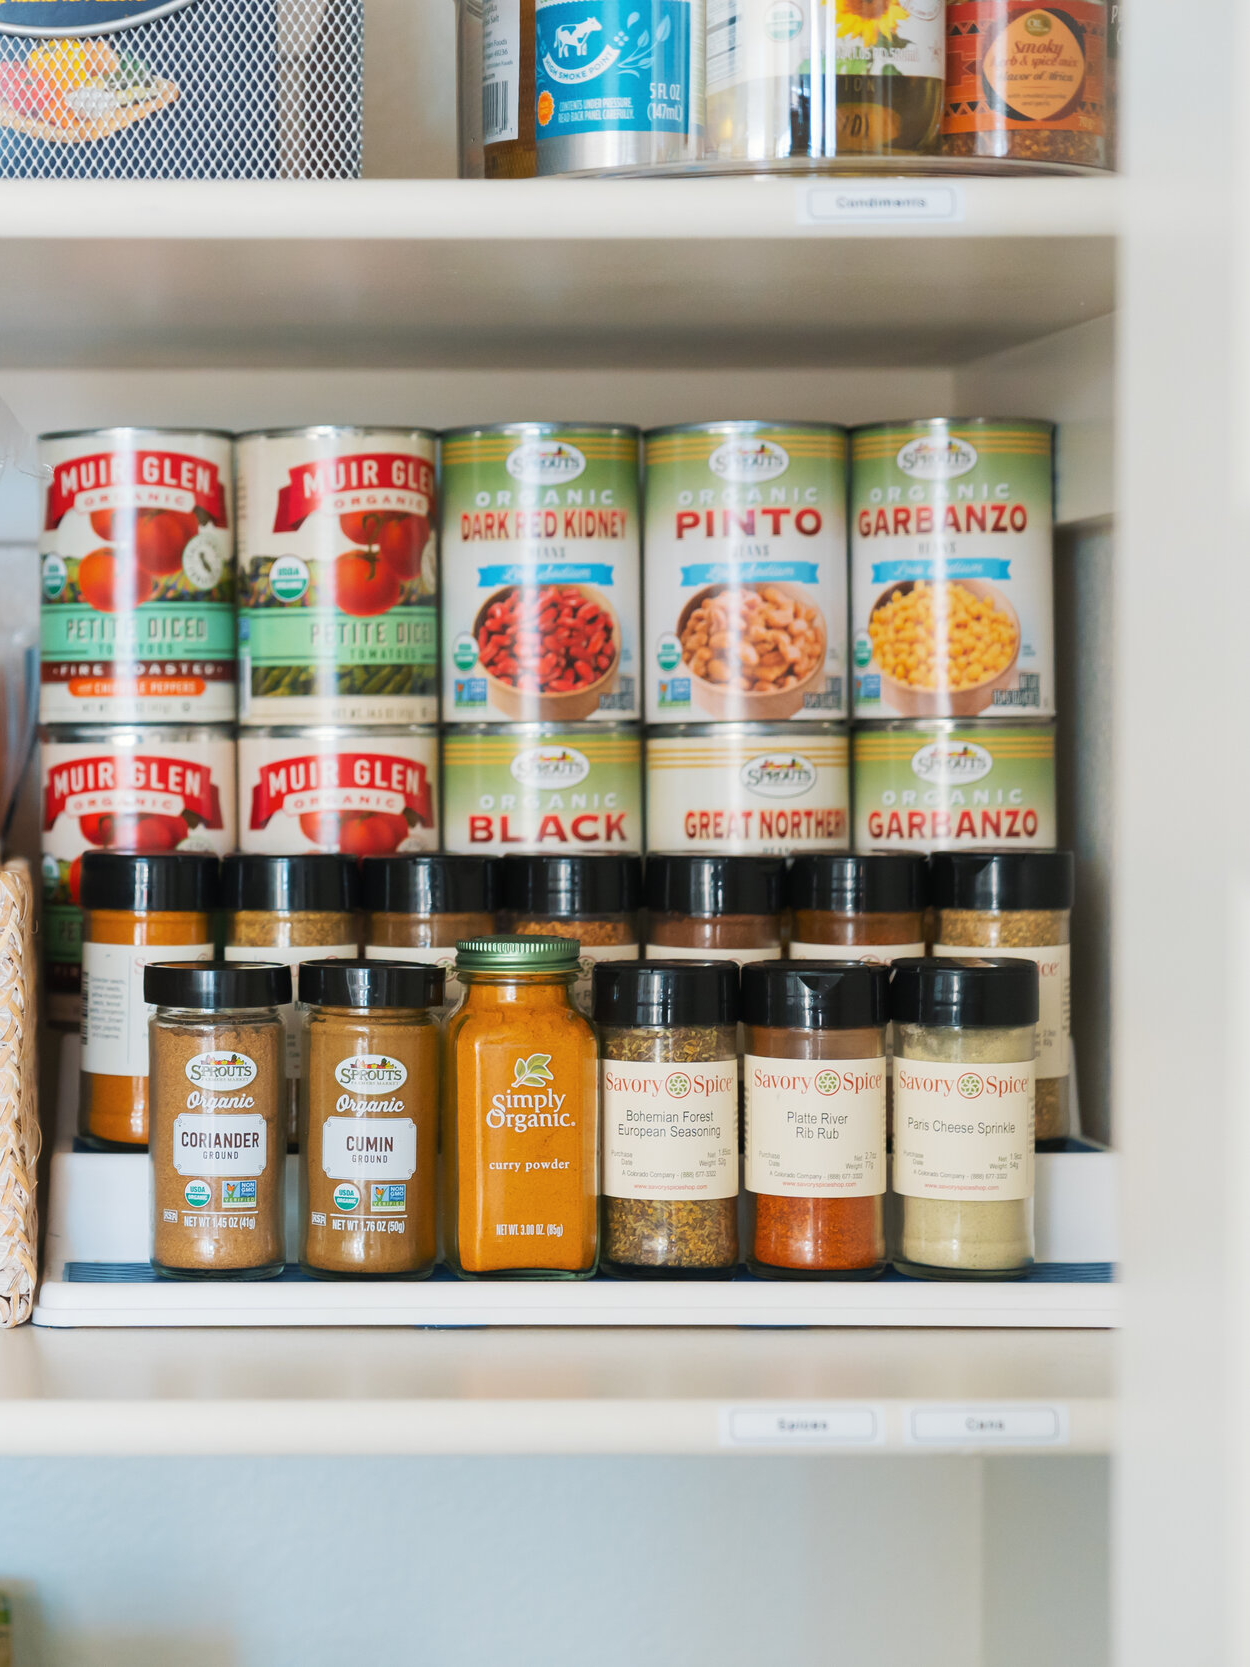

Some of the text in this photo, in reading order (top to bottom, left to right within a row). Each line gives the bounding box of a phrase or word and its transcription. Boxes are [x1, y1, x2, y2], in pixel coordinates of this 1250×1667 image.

[1014, 39, 1064, 59] Smoky
[544, 49, 613, 81] HIGH SMOKE POINT
[649, 83, 681, 100] 5 FL OZ
[647, 102, 682, 122] (147mL)
[143, 456, 212, 499] GLEN
[303, 458, 382, 501] MUIR
[476, 488, 616, 507] ORGANIC
[678, 485, 818, 507] ORGANIC
[869, 482, 1010, 504] ORGANIC
[461, 508, 628, 541] DARK RED KIDNEY
[676, 507, 823, 540] PINTO
[858, 503, 1028, 538] GARBANZO
[148, 616, 207, 642] DICED
[310, 618, 388, 648] PETITE
[59, 660, 104, 675] FIRE
[150, 679, 197, 693] PEPPERS
[54, 760, 202, 800] MUIR GLEN
[268, 759, 421, 800] MUIR GLEN
[747, 766, 812, 788] SPROUTS
[295, 793, 397, 810] ORGANIC
[479, 792, 619, 811] ORGANIC
[882, 788, 1023, 806] ORGANIC
[468, 813, 628, 843] BLACK
[684, 811, 754, 840] GREAT
[868, 809, 1038, 840] GARBANZO
[190, 1065, 253, 1082] SPROUTS
[340, 1068, 403, 1085] SPROUTS
[754, 1068, 881, 1095] Savory Spice
[605, 1071, 731, 1097] Savory Spice
[899, 1070, 1026, 1098] Savory Spice
[186, 1090, 256, 1114] Organic
[336, 1093, 406, 1117] Organic
[492, 1088, 567, 1112] Simply
[486, 1107, 577, 1133] Organic.
[626, 1109, 715, 1124] Bohemian Forest
[786, 1110, 849, 1125] Platte River
[908, 1116, 1016, 1137] Paris Cheese Sprinkle
[181, 1131, 260, 1149] CORIANDER
[618, 1124, 721, 1140] European Seasoning
[795, 1126, 840, 1140] Rib Rub
[346, 1135, 395, 1153] CUMIN
[202, 1151, 240, 1161] GROUND
[352, 1154, 389, 1164] GROUND
[489, 1158, 571, 1176] curry powder
[627, 1171, 676, 1182] Colorado Company
[775, 1170, 822, 1182] Colorado Company
[939, 1171, 965, 1183] Company
[339, 1189, 355, 1197] USDA
[184, 1216, 198, 1228] NET
[199, 1217, 211, 1228] WT
[212, 1217, 228, 1229] 1.45
[229, 1216, 238, 1229] OZ
[239, 1215, 256, 1231] (41g)
[332, 1219, 346, 1231] NET
[347, 1219, 359, 1231] WT
[360, 1220, 376, 1233] 1.76
[377, 1220, 387, 1232] OZ
[388, 1220, 406, 1234] (50g)
[496, 1224, 507, 1236] NET
[520, 1224, 534, 1236] 3.00
[546, 1224, 565, 1237] (85g)
